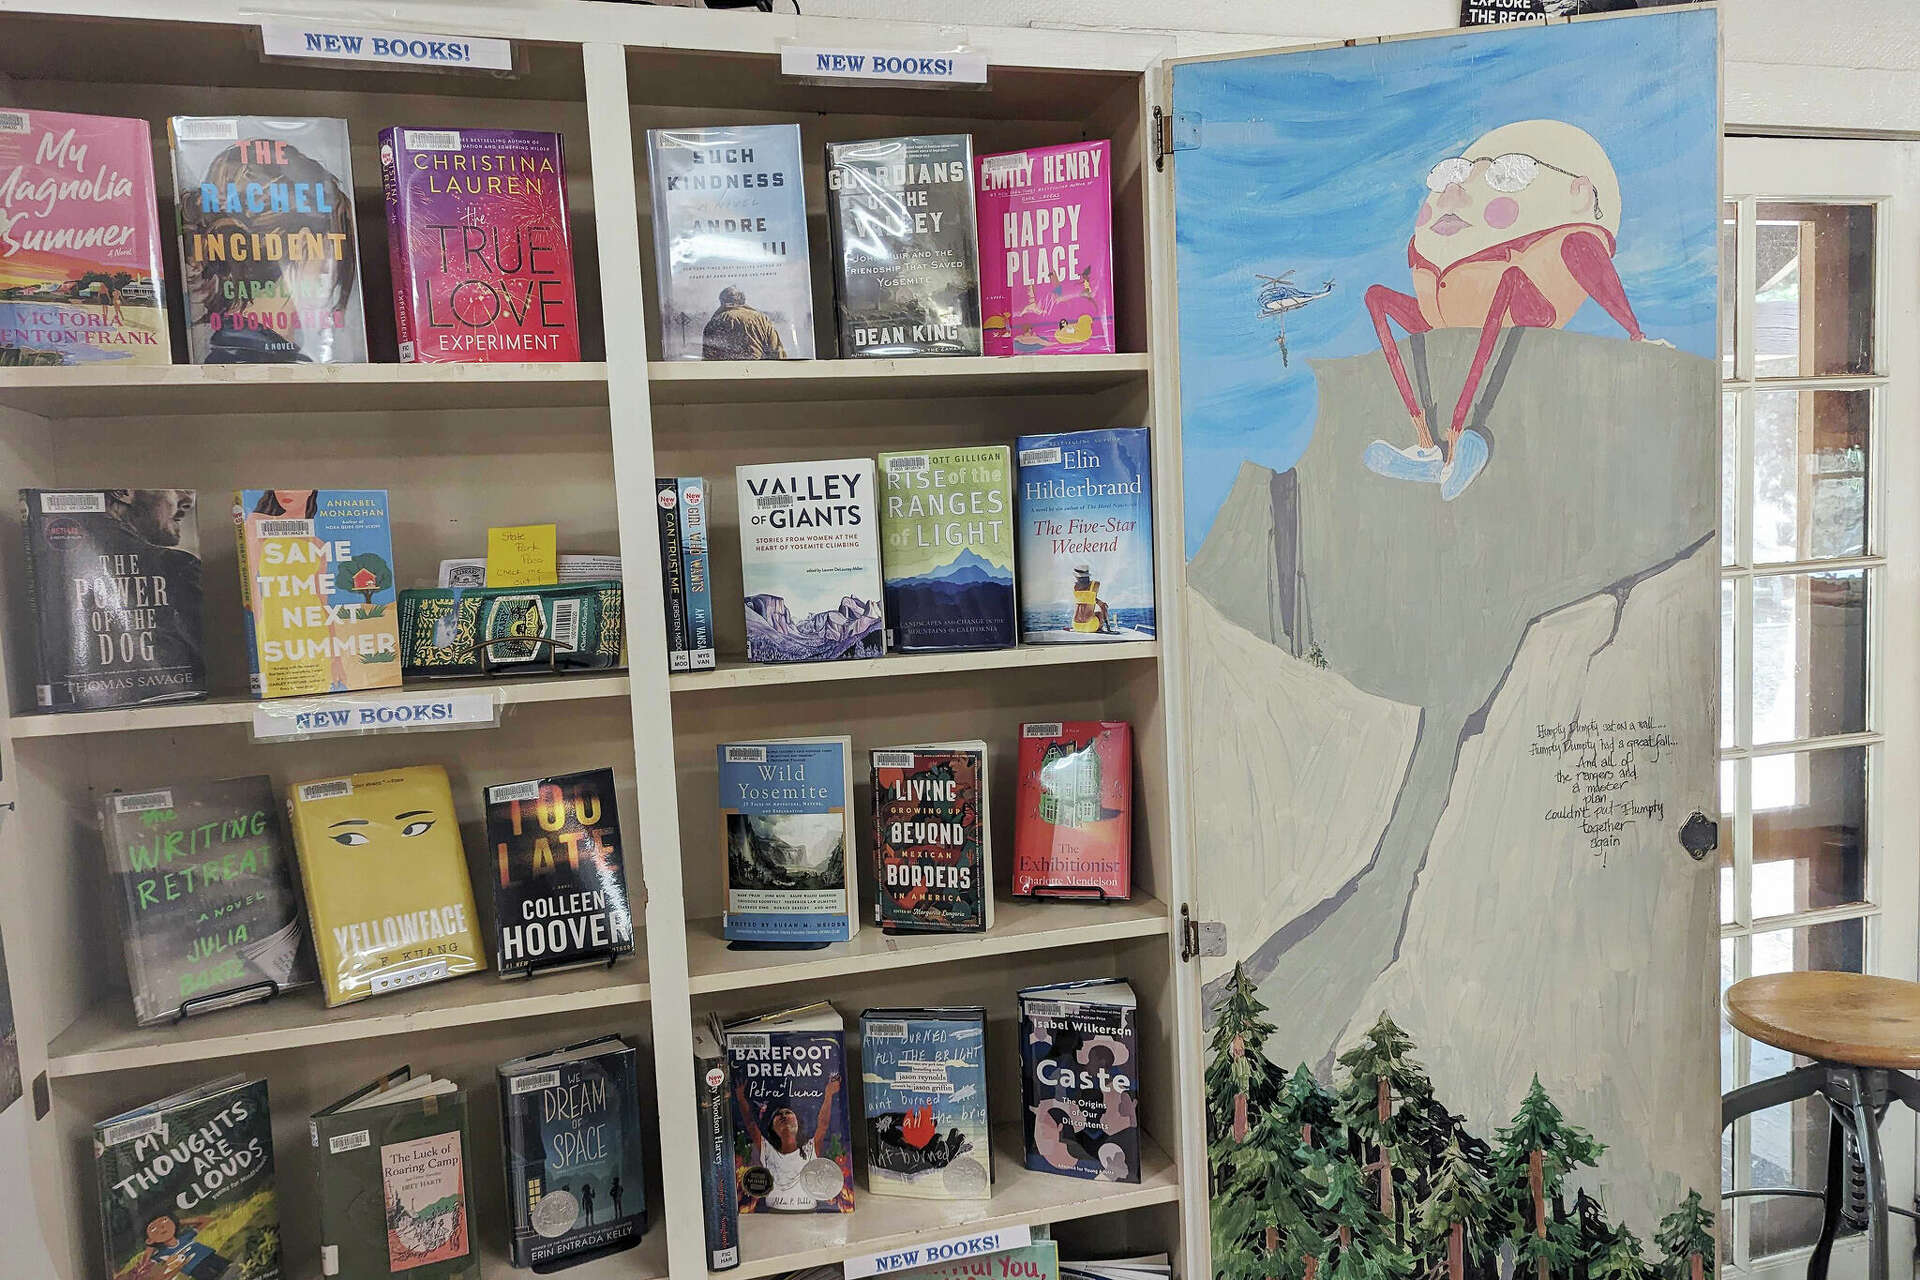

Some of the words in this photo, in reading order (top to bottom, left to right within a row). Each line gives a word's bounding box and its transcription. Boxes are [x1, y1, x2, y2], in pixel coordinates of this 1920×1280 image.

[1469, 9, 1496, 24] THE
[304, 32, 364, 55] NEW
[372, 37, 471, 62] BOOKS!
[816, 53, 866, 73] NEW
[872, 56, 953, 76] BOOKS!
[35, 128, 89, 173] My
[235, 140, 289, 166] THE
[693, 148, 755, 165] SUCH
[413, 153, 555, 174] CHRISTINA
[1043, 149, 1103, 185] HENRY
[429, 175, 542, 195] LAUREN
[667, 172, 785, 191] KINDNESS
[200, 183, 333, 214] RACHEL
[896, 190, 928, 207] THE
[1, 208, 136, 258] Summer
[693, 217, 767, 233] ANDRE
[1003, 204, 1082, 249] HAPPY
[193, 233, 348, 262] INCIDENT
[426, 225, 555, 275] TRUE
[911, 250, 932, 259] AND
[935, 249, 953, 257] THE
[931, 260, 963, 270] SAVED
[1006, 244, 1081, 288] PLACE
[426, 279, 566, 329] LOVE
[16, 311, 124, 327] VICTORIA
[81, 329, 159, 345] FRANK
[439, 333, 561, 352] EXPERIMENT
[854, 326, 905, 346] DEAN
[912, 324, 958, 343] KING
[954, 453, 1001, 463] GILLIGAN
[1063, 449, 1101, 470] Elin
[746, 473, 862, 502] VALLEY
[887, 470, 947, 490] RISE
[948, 467, 967, 485] of
[971, 466, 1002, 483] the
[1025, 474, 1142, 501] Hilderbrand
[319, 509, 384, 517] MONAGHAN
[326, 499, 376, 507] ANNABEL
[889, 490, 1004, 518] RANGES
[665, 512, 676, 537] CAN
[688, 507, 701, 528] GIRL
[751, 515, 767, 525] OF
[769, 505, 862, 529] GIANTS
[1033, 520, 1063, 536] The
[1068, 517, 1137, 534] Five-Star
[916, 520, 1004, 547] LIGHT
[264, 540, 353, 565] SAME
[1052, 536, 1119, 554] Weekend
[98, 554, 140, 576] THE
[667, 538, 679, 575] TRUST
[257, 573, 337, 598] TIME
[670, 577, 680, 594] ME
[690, 559, 705, 592] WANTS
[74, 575, 169, 610] POWER
[282, 603, 362, 629] NEXT
[955, 625, 998, 633] CALIFORNIA
[98, 631, 155, 665] DOG
[263, 632, 396, 663] SUMMER
[137, 672, 193, 688] SAVAGE
[296, 709, 351, 729] NEW
[359, 702, 453, 725] BOOKS!
[1562, 740, 1597, 759] Dumpty
[1600, 737, 1615, 752] had
[1576, 756, 1598, 768] And
[1600, 752, 1617, 767] all
[1621, 752, 1634, 766] of
[758, 764, 805, 781] Wild
[1554, 770, 1573, 783] the
[1576, 770, 1614, 784] rangers
[1619, 765, 1637, 780] and
[738, 783, 828, 800] Yosemite
[895, 779, 957, 802] LIVING
[1572, 782, 1581, 793] a
[1586, 781, 1629, 793] master
[890, 807, 942, 815] GROWING
[1582, 794, 1607, 808] plan
[1621, 799, 1664, 822] Humpty
[891, 821, 965, 846] BEYOND
[1577, 818, 1636, 838] together
[129, 811, 267, 873] WRITING
[1058, 843, 1080, 854] The
[1590, 834, 1621, 857] again
[498, 829, 619, 888] LATE
[902, 850, 953, 859] MEXICAN
[1019, 855, 1121, 873] Exhibitionist
[137, 845, 271, 911] RETREAT
[887, 864, 971, 889] BORDERS
[522, 890, 607, 921] COLLEEN
[911, 892, 962, 902] AMERICA
[333, 903, 468, 957] YELLOWFACE
[503, 911, 631, 960] HOOVER
[187, 924, 248, 963] JULIA
[1033, 1018, 1069, 1031] Isabel
[1071, 1021, 1132, 1037] Wilkerson
[735, 1045, 832, 1061] BAREFOOT
[874, 1051, 896, 1066] ALL
[902, 1049, 926, 1061] THE
[935, 1045, 983, 1062] BRIGHT
[567, 1072, 581, 1085] WE
[747, 1062, 823, 1077] DREAMS
[918, 1073, 947, 1082] reynolds
[1036, 1059, 1131, 1093] Caste
[749, 1080, 784, 1098] Petra
[788, 1083, 823, 1098] Luna
[900, 1091, 940, 1106] burned
[931, 1084, 953, 1092] griffin
[543, 1076, 607, 1124] DREAM
[1062, 1096, 1076, 1106] The
[1078, 1099, 1107, 1110] Origins
[571, 1118, 582, 1129] OF
[712, 1095, 722, 1134] Woodson
[903, 1110, 922, 1128] all
[930, 1110, 952, 1126] the
[1062, 1117, 1109, 1130] Discontents
[1071, 1109, 1081, 1117] of
[1082, 1110, 1098, 1119] Our
[112, 1100, 249, 1199] THOUGHTS
[134, 1122, 169, 1162] MY
[552, 1123, 608, 1169] SPACE
[713, 1135, 723, 1166] Harvey
[193, 1138, 233, 1176] ARE
[389, 1153, 411, 1165] The
[413, 1147, 438, 1160] Luck
[441, 1143, 452, 1155] of
[176, 1137, 263, 1210] CLOUDS
[384, 1163, 426, 1177] Roaring
[428, 1156, 459, 1169] Camp
[531, 1247, 554, 1261] ERIN
[557, 1235, 604, 1254] ENTRADA
[606, 1226, 633, 1240] KELLY
[875, 1251, 920, 1272] NEW
[926, 1234, 1000, 1263] BOOKS!
[998, 1255, 1047, 1280] You,
